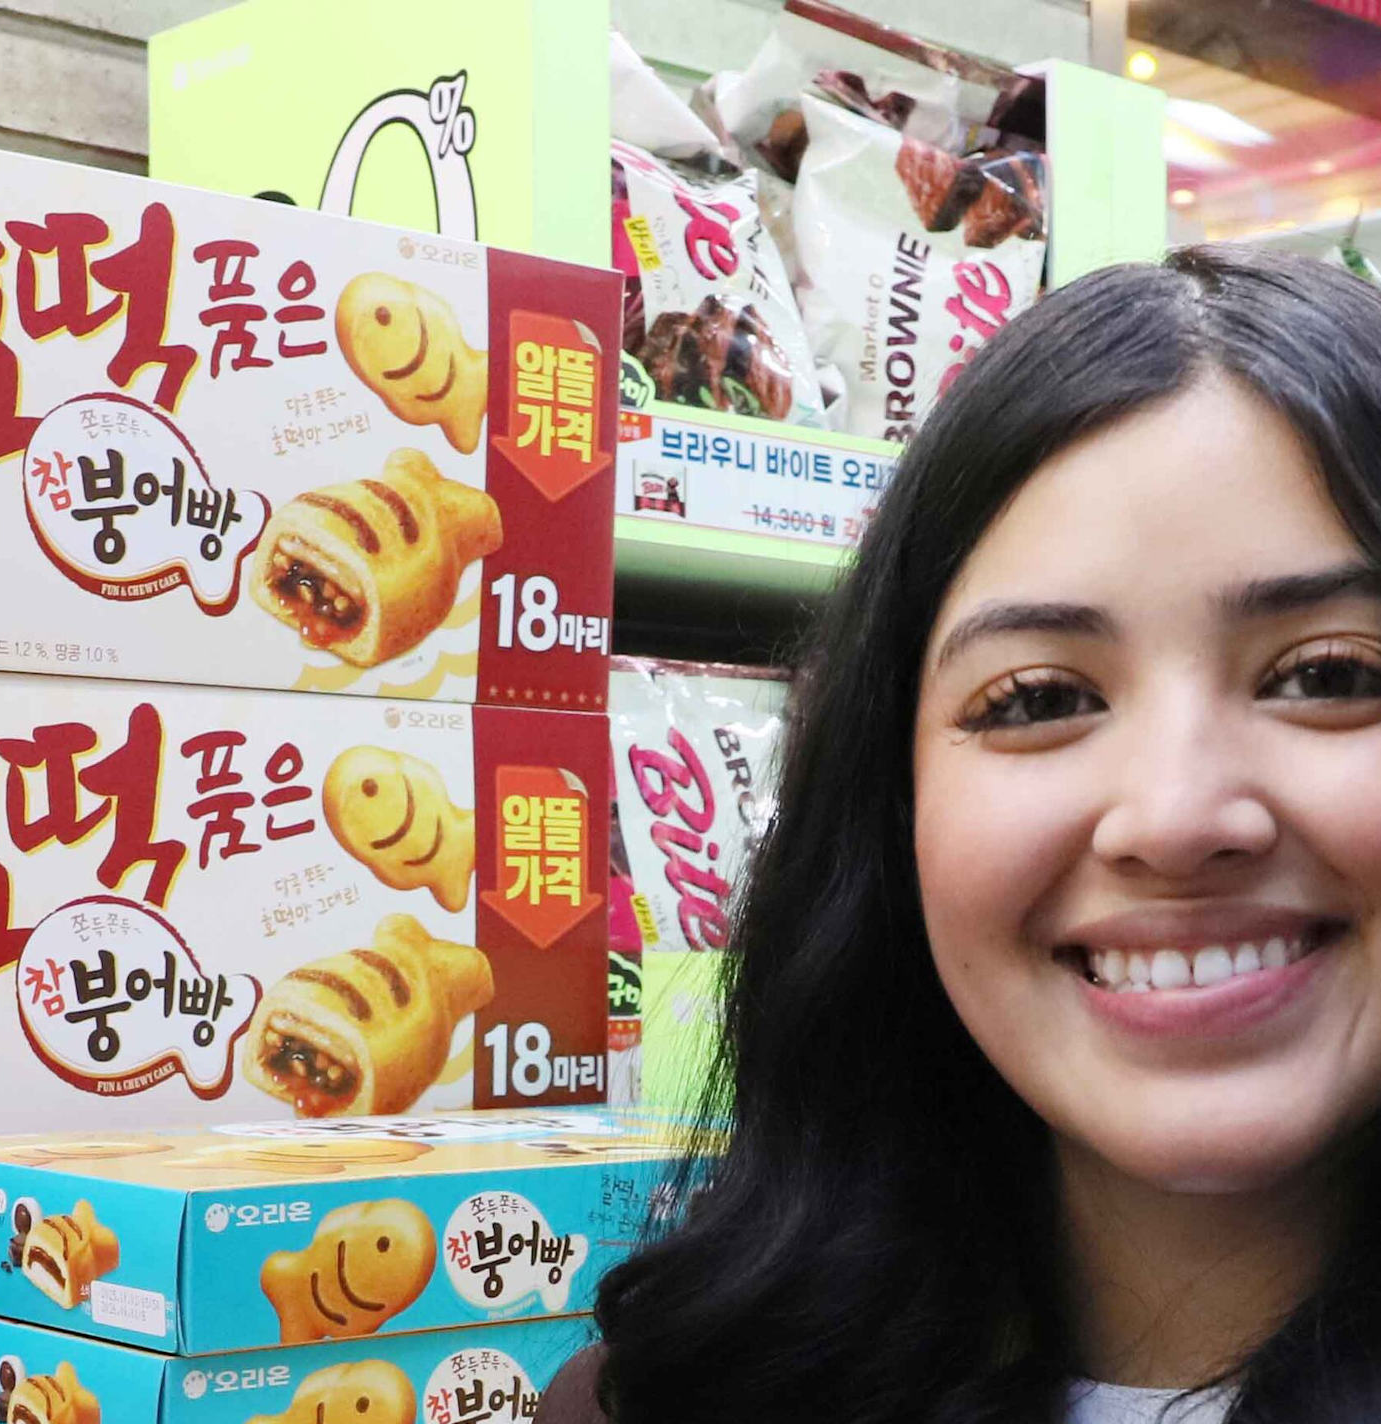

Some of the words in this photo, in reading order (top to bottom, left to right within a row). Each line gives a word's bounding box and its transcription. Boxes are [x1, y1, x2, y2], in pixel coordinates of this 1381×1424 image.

[192, 240, 327, 380] 품은
[515, 339, 595, 401] 알뜰
[517, 405, 593, 463] 가격
[662, 429, 756, 472] 브라우니
[767, 445, 832, 483] 바이트
[492, 574, 607, 656] 18마리
[181, 731, 316, 871] 품은
[503, 795, 582, 853] 알뜰
[506, 854, 582, 908] 가격
[484, 1023, 604, 1096] 18마리
[236, 1201, 311, 1228] 오리온
[213, 1365, 291, 1394] 오리온
